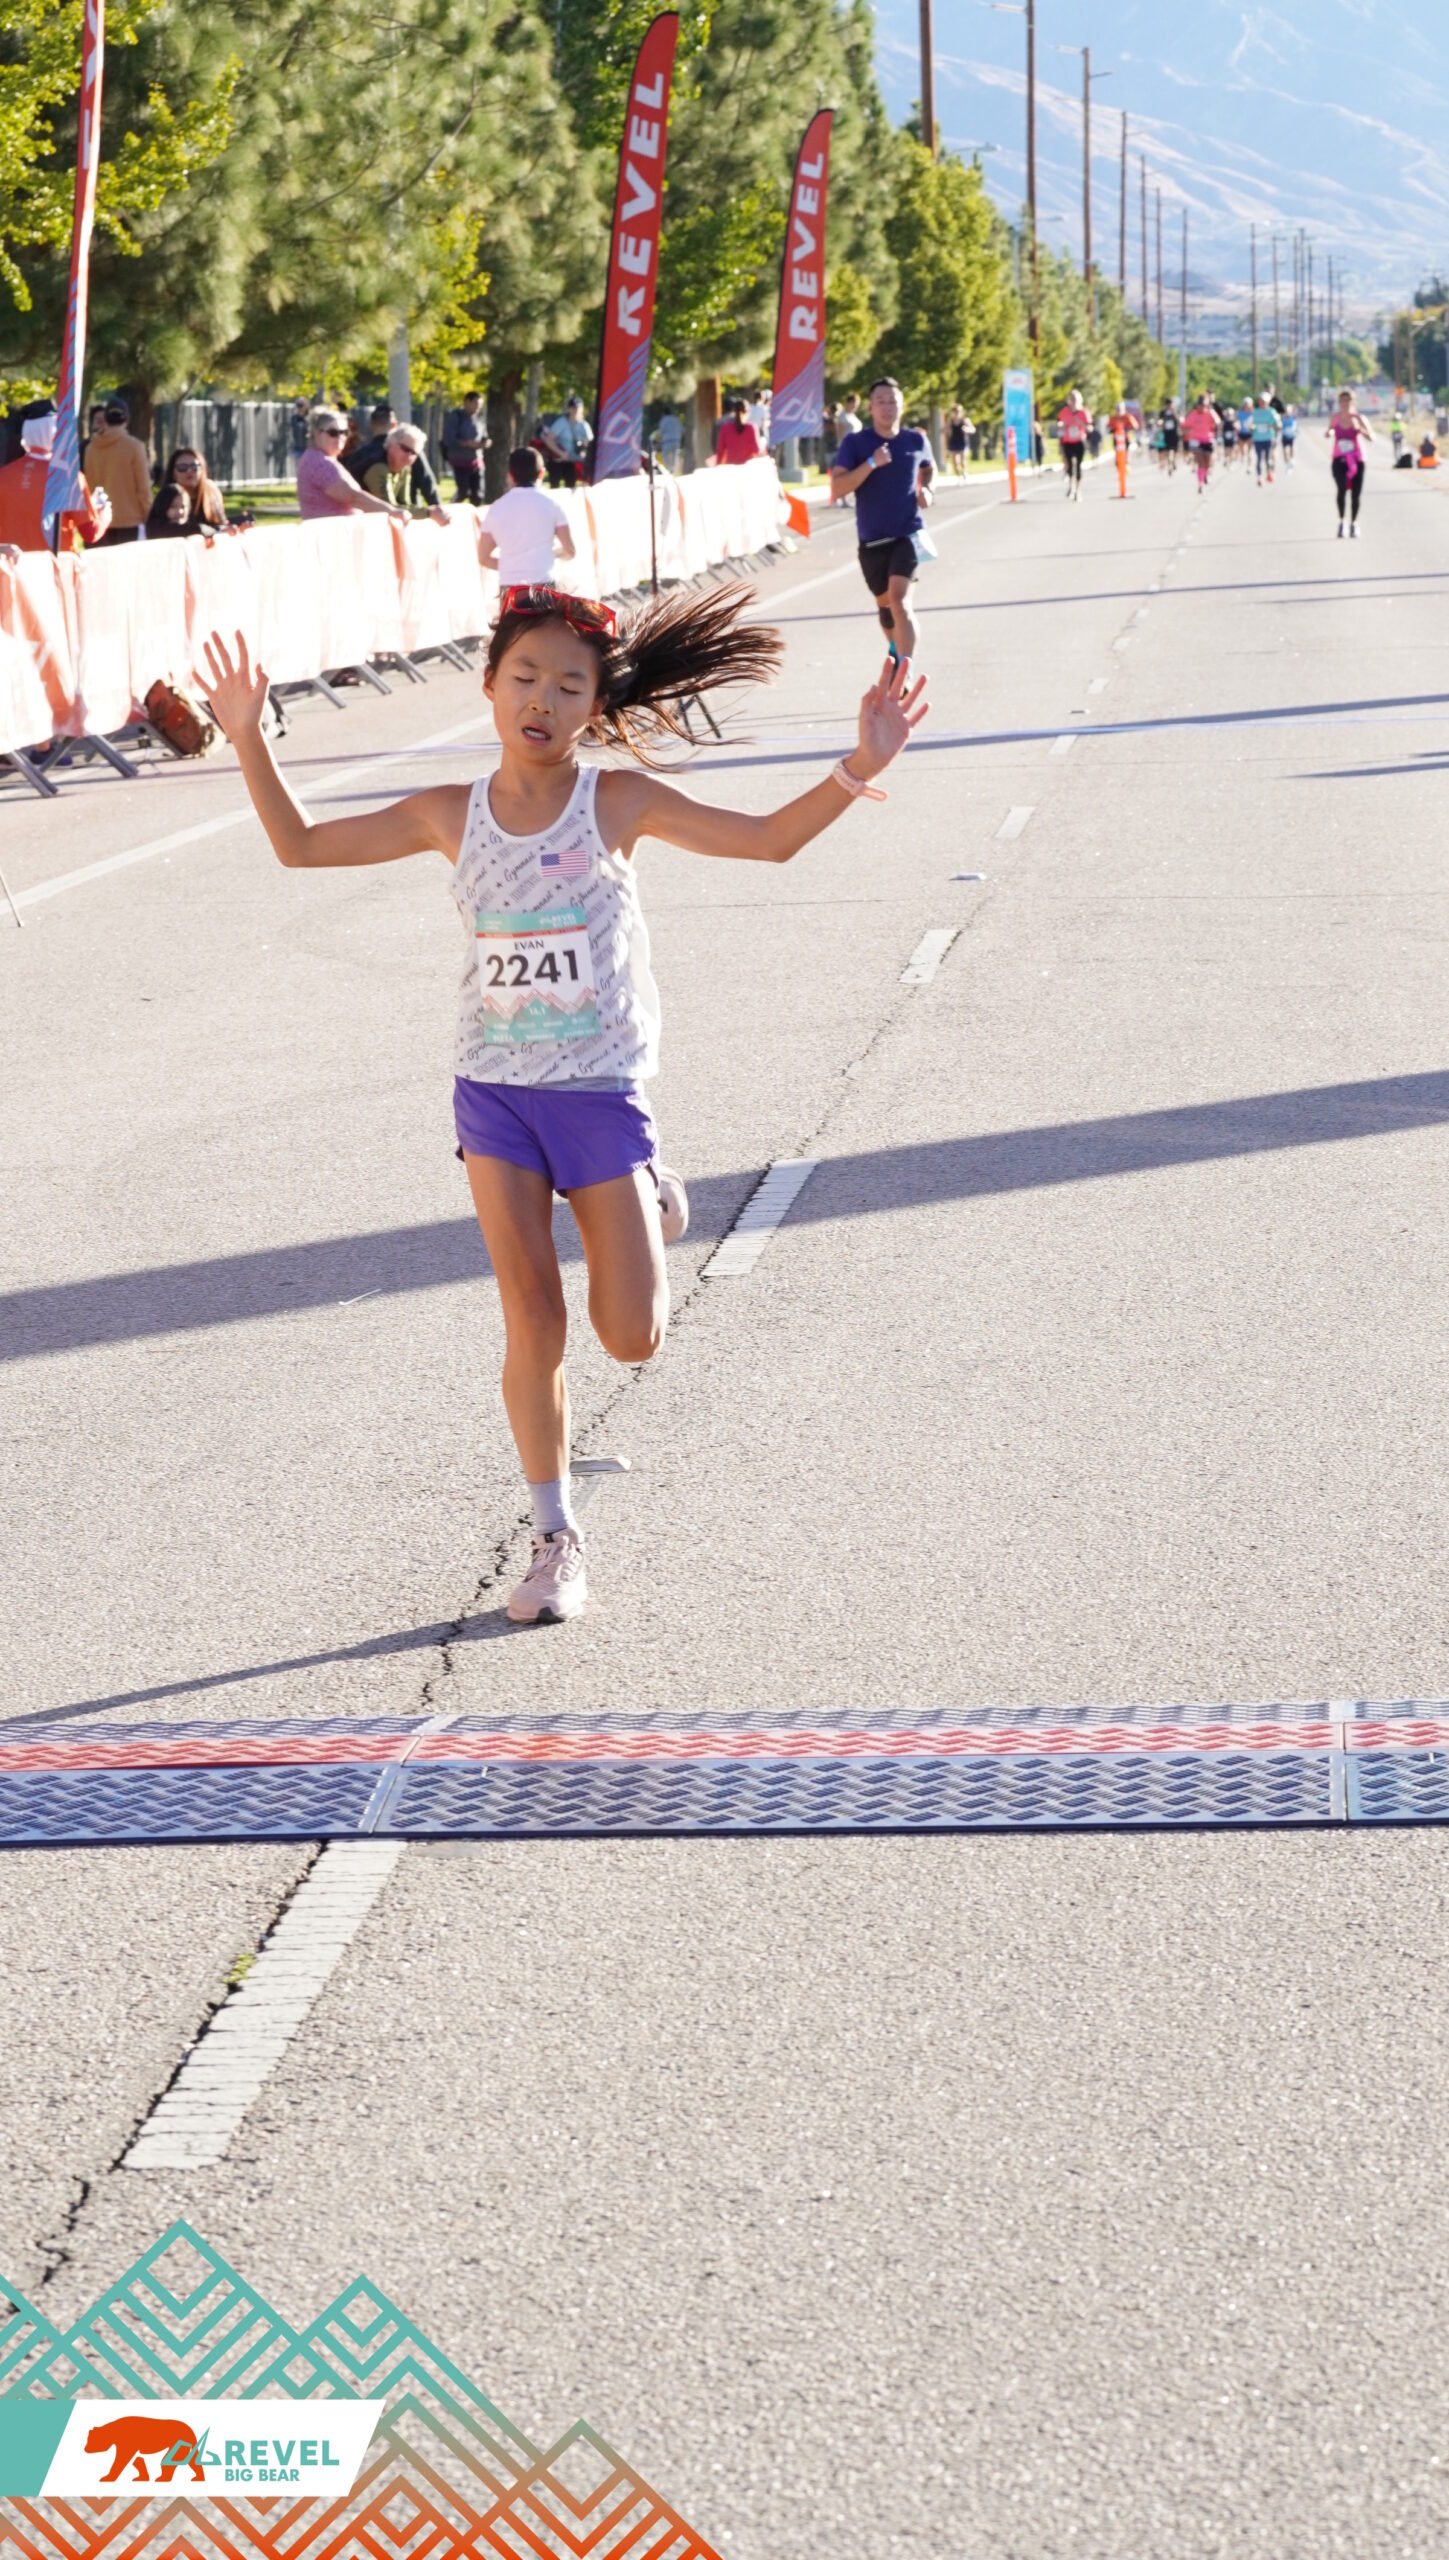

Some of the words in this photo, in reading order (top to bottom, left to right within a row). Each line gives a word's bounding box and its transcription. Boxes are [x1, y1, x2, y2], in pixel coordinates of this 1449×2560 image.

[617, 73, 664, 336] REVEL
[789, 153, 824, 342] REVEL
[504, 852, 536, 882] Gymnast
[514, 940, 544, 950] EVAN
[486, 949, 579, 987] 2241
